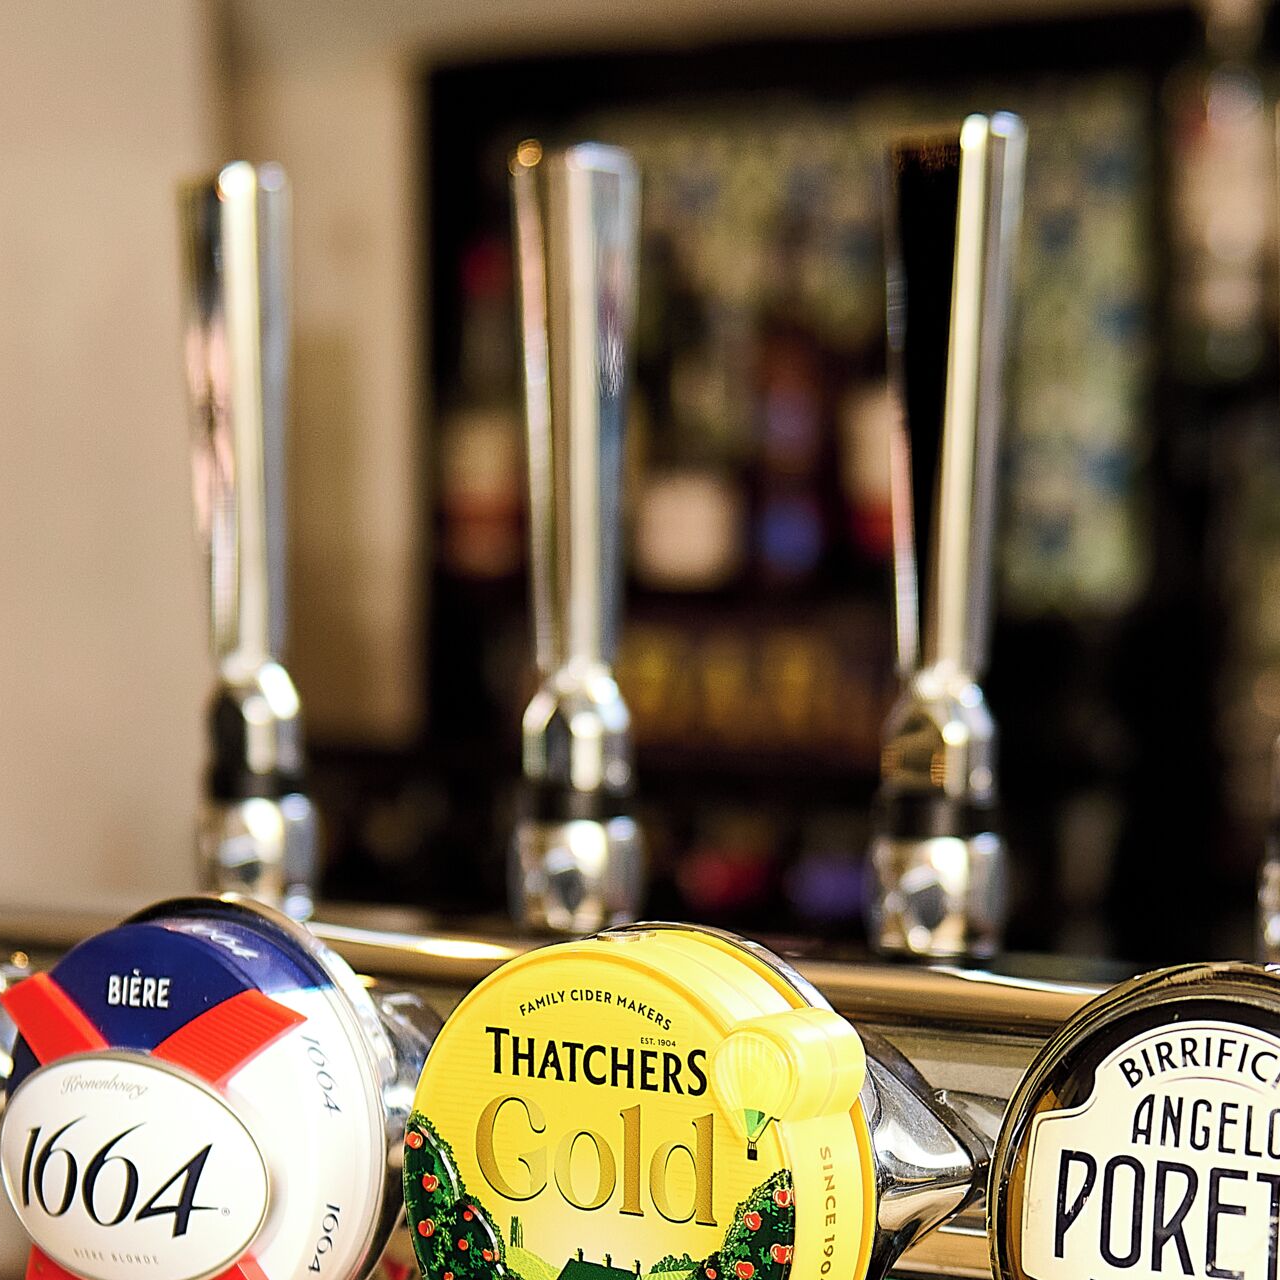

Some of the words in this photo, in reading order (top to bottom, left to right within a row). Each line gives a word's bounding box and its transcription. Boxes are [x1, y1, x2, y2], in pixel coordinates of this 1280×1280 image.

[108, 969, 172, 1009] BIÈRE
[519, 990, 566, 1017] FAMILY
[570, 989, 613, 1004] CIDER
[616, 994, 673, 1031] MAKERS
[300, 1034, 341, 1116] 1664
[485, 1025, 708, 1097] THATCHERS
[640, 1037, 656, 1046] EST.
[657, 1039, 677, 1047] 1904
[60, 1073, 148, 1100] Kronenbourg
[22, 1115, 220, 1239] 1664
[475, 1094, 719, 1228] Gold
[820, 1146, 836, 1228] SINCE
[111, 1252, 159, 1265] BLONDE
[307, 1203, 341, 1275] 1664
